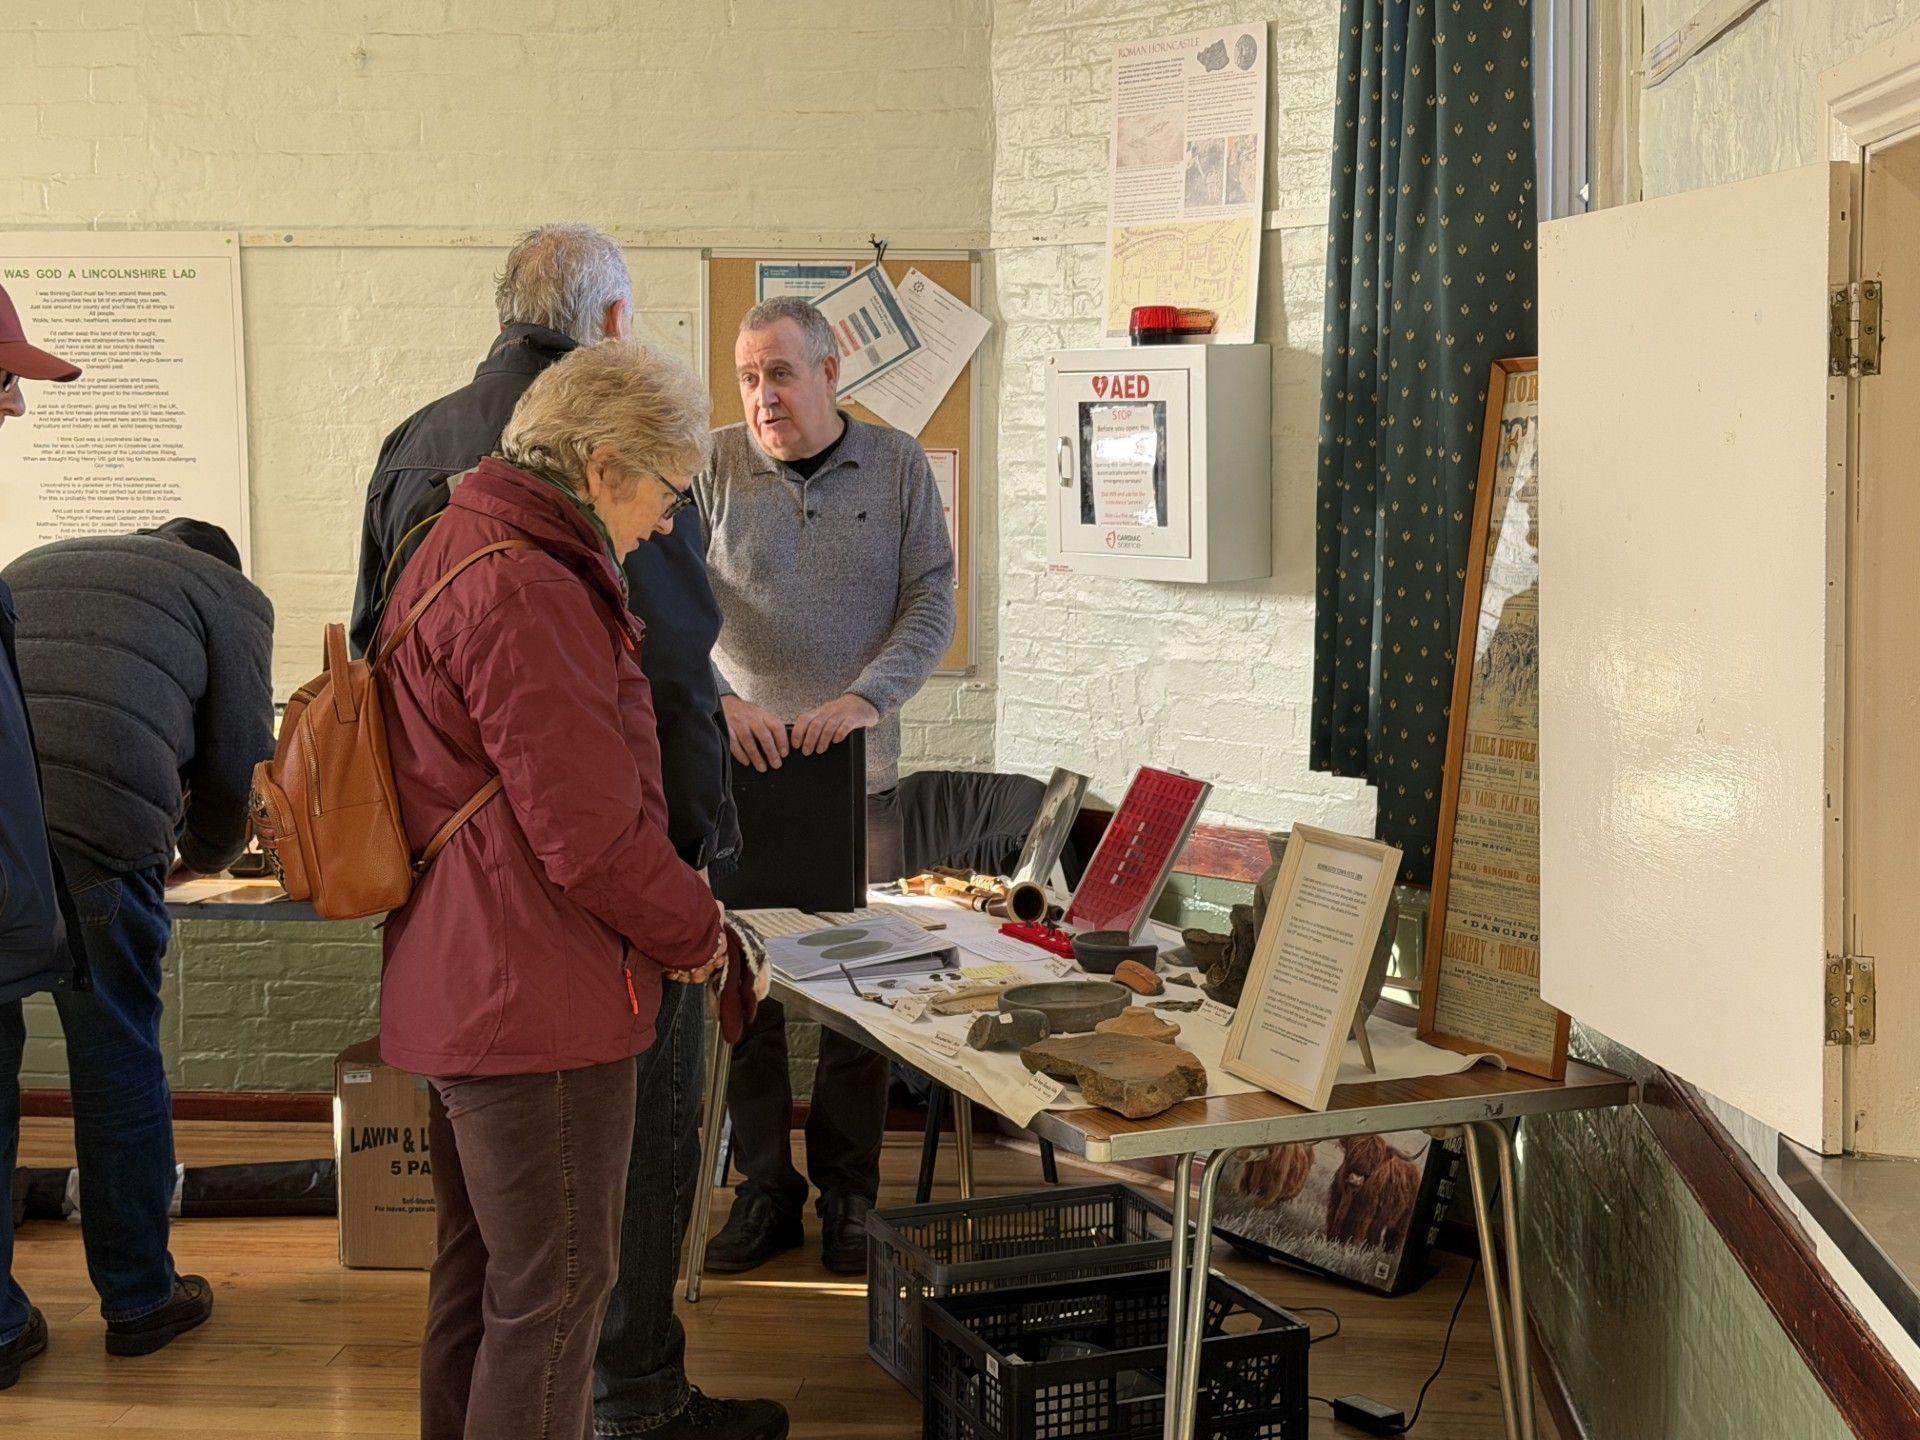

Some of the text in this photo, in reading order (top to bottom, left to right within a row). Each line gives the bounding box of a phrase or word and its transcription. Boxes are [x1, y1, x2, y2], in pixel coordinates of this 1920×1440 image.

[1117, 37, 1200, 58] ROMAN HORNCASTLE
[4, 269, 196, 278] WAS GOD A LINCOLNSHIRE LAD
[1110, 375, 1150, 399] AED
[1112, 410, 1132, 420] STOP
[1473, 736, 1496, 756] MILE
[1498, 738, 1536, 762] BICYCLE
[1476, 790, 1497, 809] YARDS
[1502, 794, 1519, 813] FLAT
[1454, 838, 1511, 852] QUOIT MATCH
[1458, 861, 1477, 871] TWO
[1483, 866, 1519, 880] SINGING
[1471, 920, 1539, 942] DANCING
[1498, 943, 1540, 978] TOURNA
[1500, 980, 1540, 993] Sovereign
[350, 1127, 429, 1153] LAWN & L
[391, 1161, 432, 1175] 5 PA
